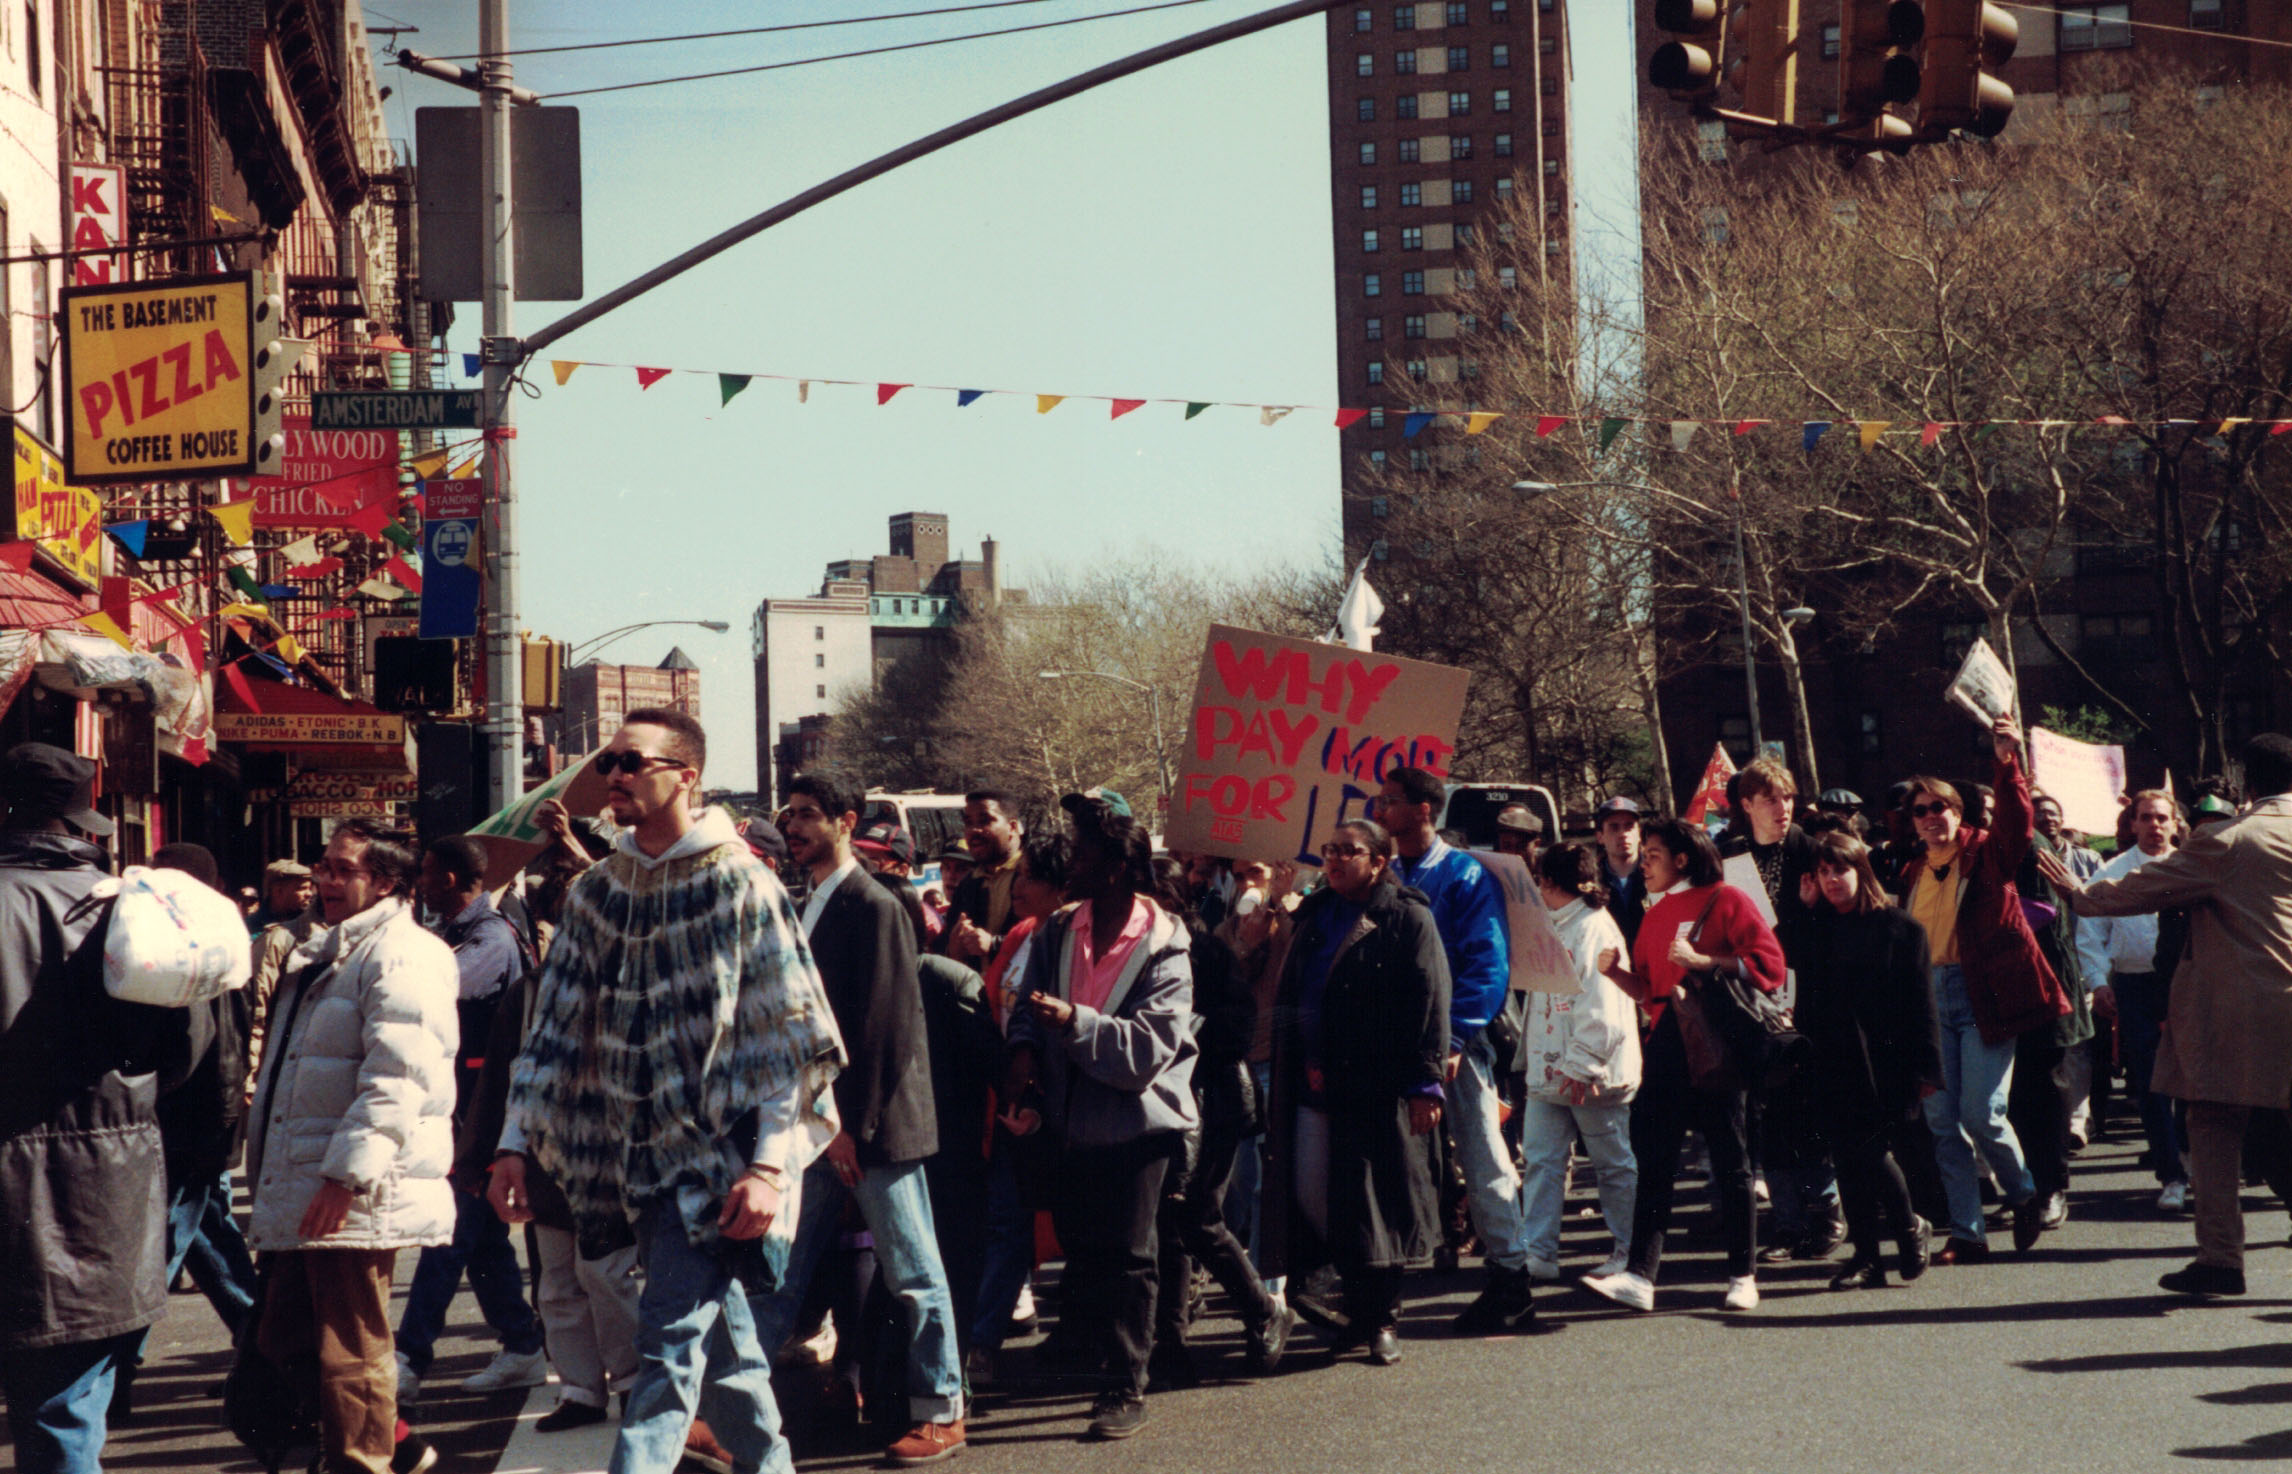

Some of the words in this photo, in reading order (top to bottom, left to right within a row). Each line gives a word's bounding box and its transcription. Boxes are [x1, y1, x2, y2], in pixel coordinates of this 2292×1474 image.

[81, 303, 115, 332] THE
[122, 295, 217, 329] BASEMENT
[79, 328, 241, 440] PIZZA
[317, 395, 445, 425] AMSTERDAM
[106, 434, 172, 465] COFFEE
[181, 429, 238, 460] HOUSE
[281, 430, 385, 460] LYWOOD
[282, 463, 332, 481] FRIED
[428, 493, 479, 506] STANDING
[444, 482, 464, 493] NO
[1213, 640, 1402, 725] WHY
[217, 727, 249, 738] NIKE
[260, 728, 298, 739] PUMA
[311, 729, 364, 740] REEBOK
[236, 716, 286, 727] ADIDAS
[297, 717, 346, 728] ETONIC
[1196, 705, 1320, 768] PAY
[1184, 773, 1297, 822] FOR
